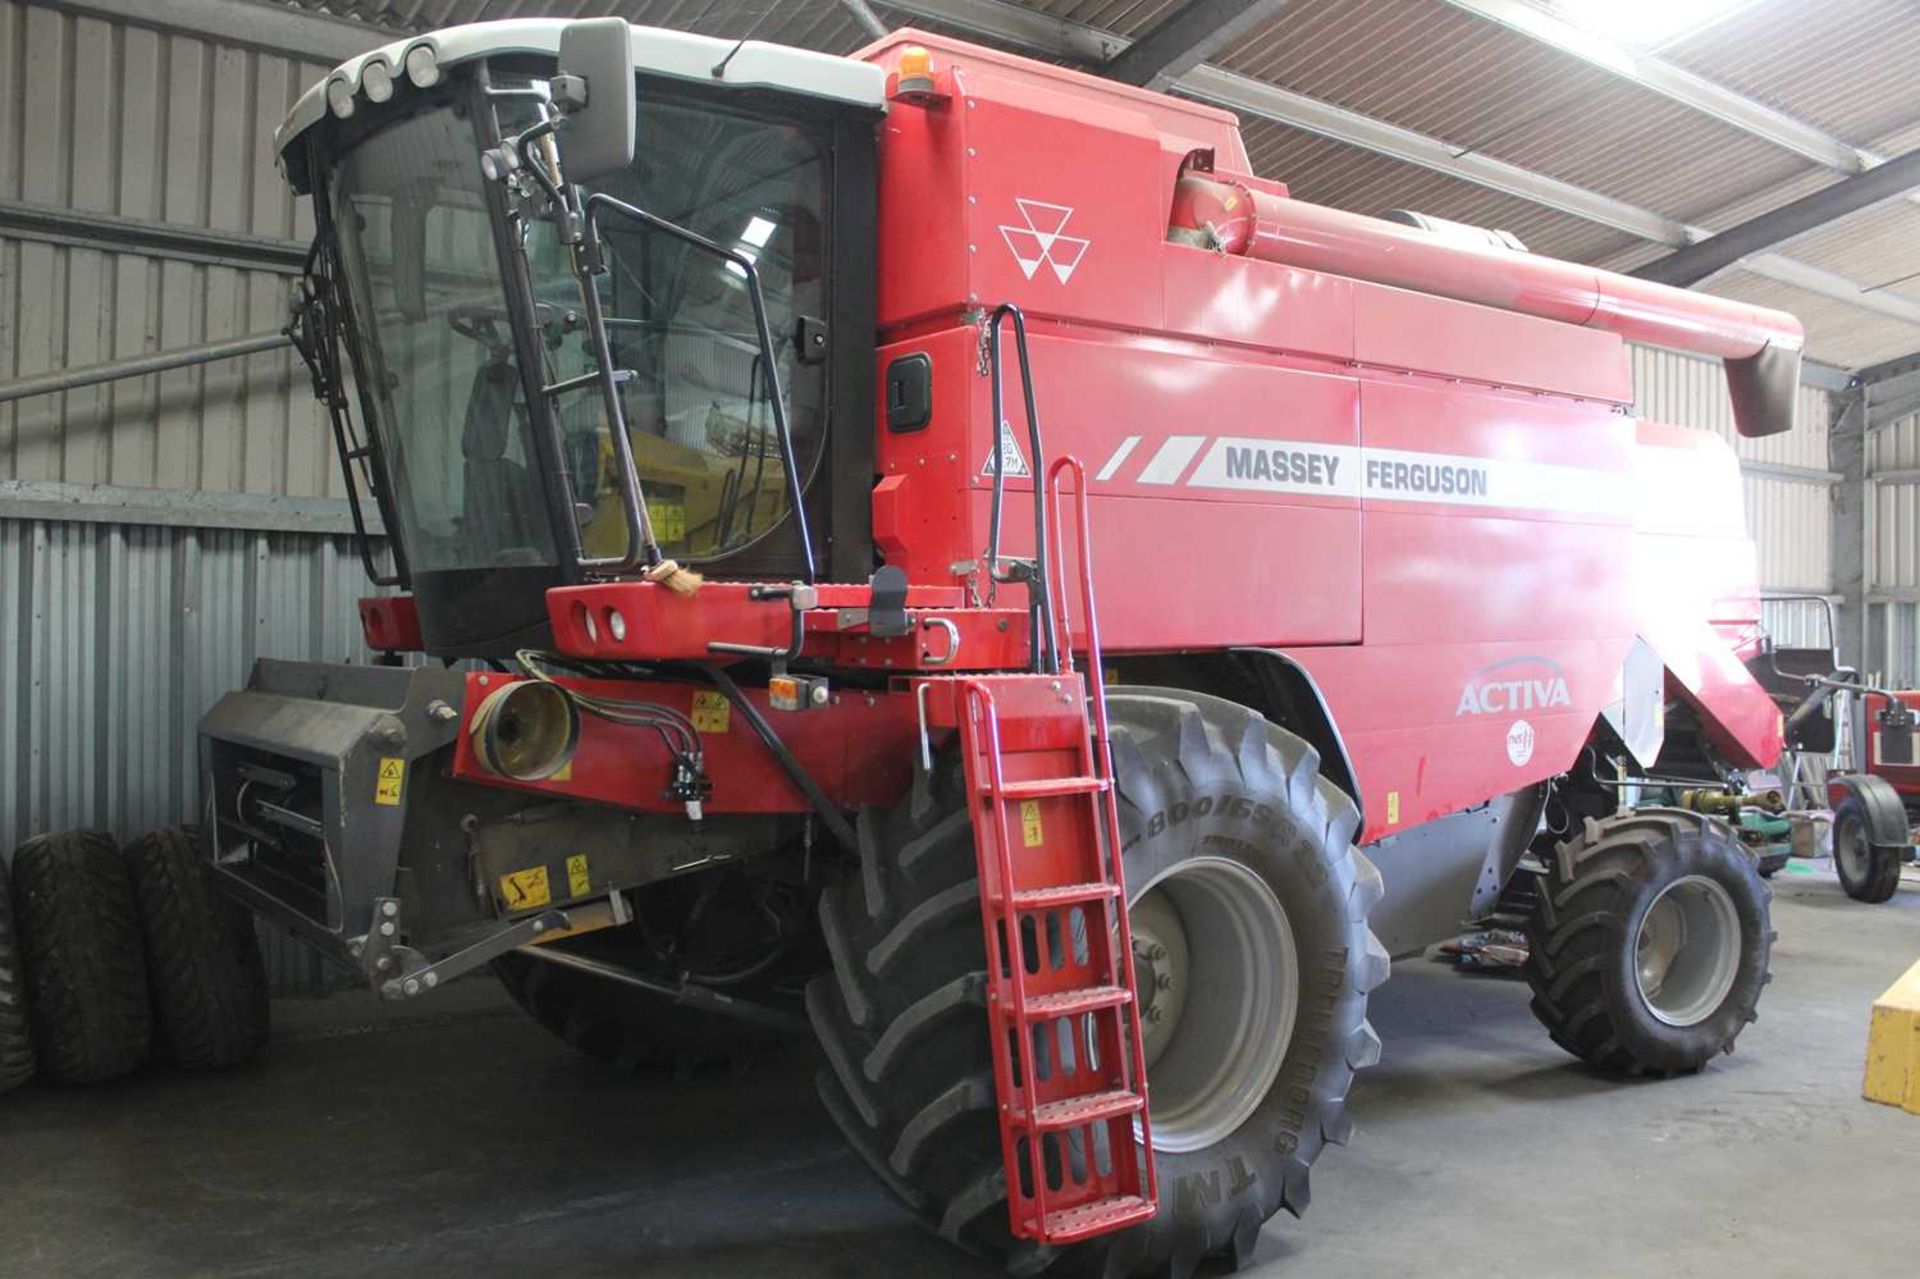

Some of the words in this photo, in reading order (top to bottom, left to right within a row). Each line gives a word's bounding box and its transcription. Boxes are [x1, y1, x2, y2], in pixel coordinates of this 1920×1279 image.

[1226, 447, 1339, 486] MASSEY
[1367, 460, 1487, 496] FERGUSON
[1456, 678, 1571, 716] ACTIVA
